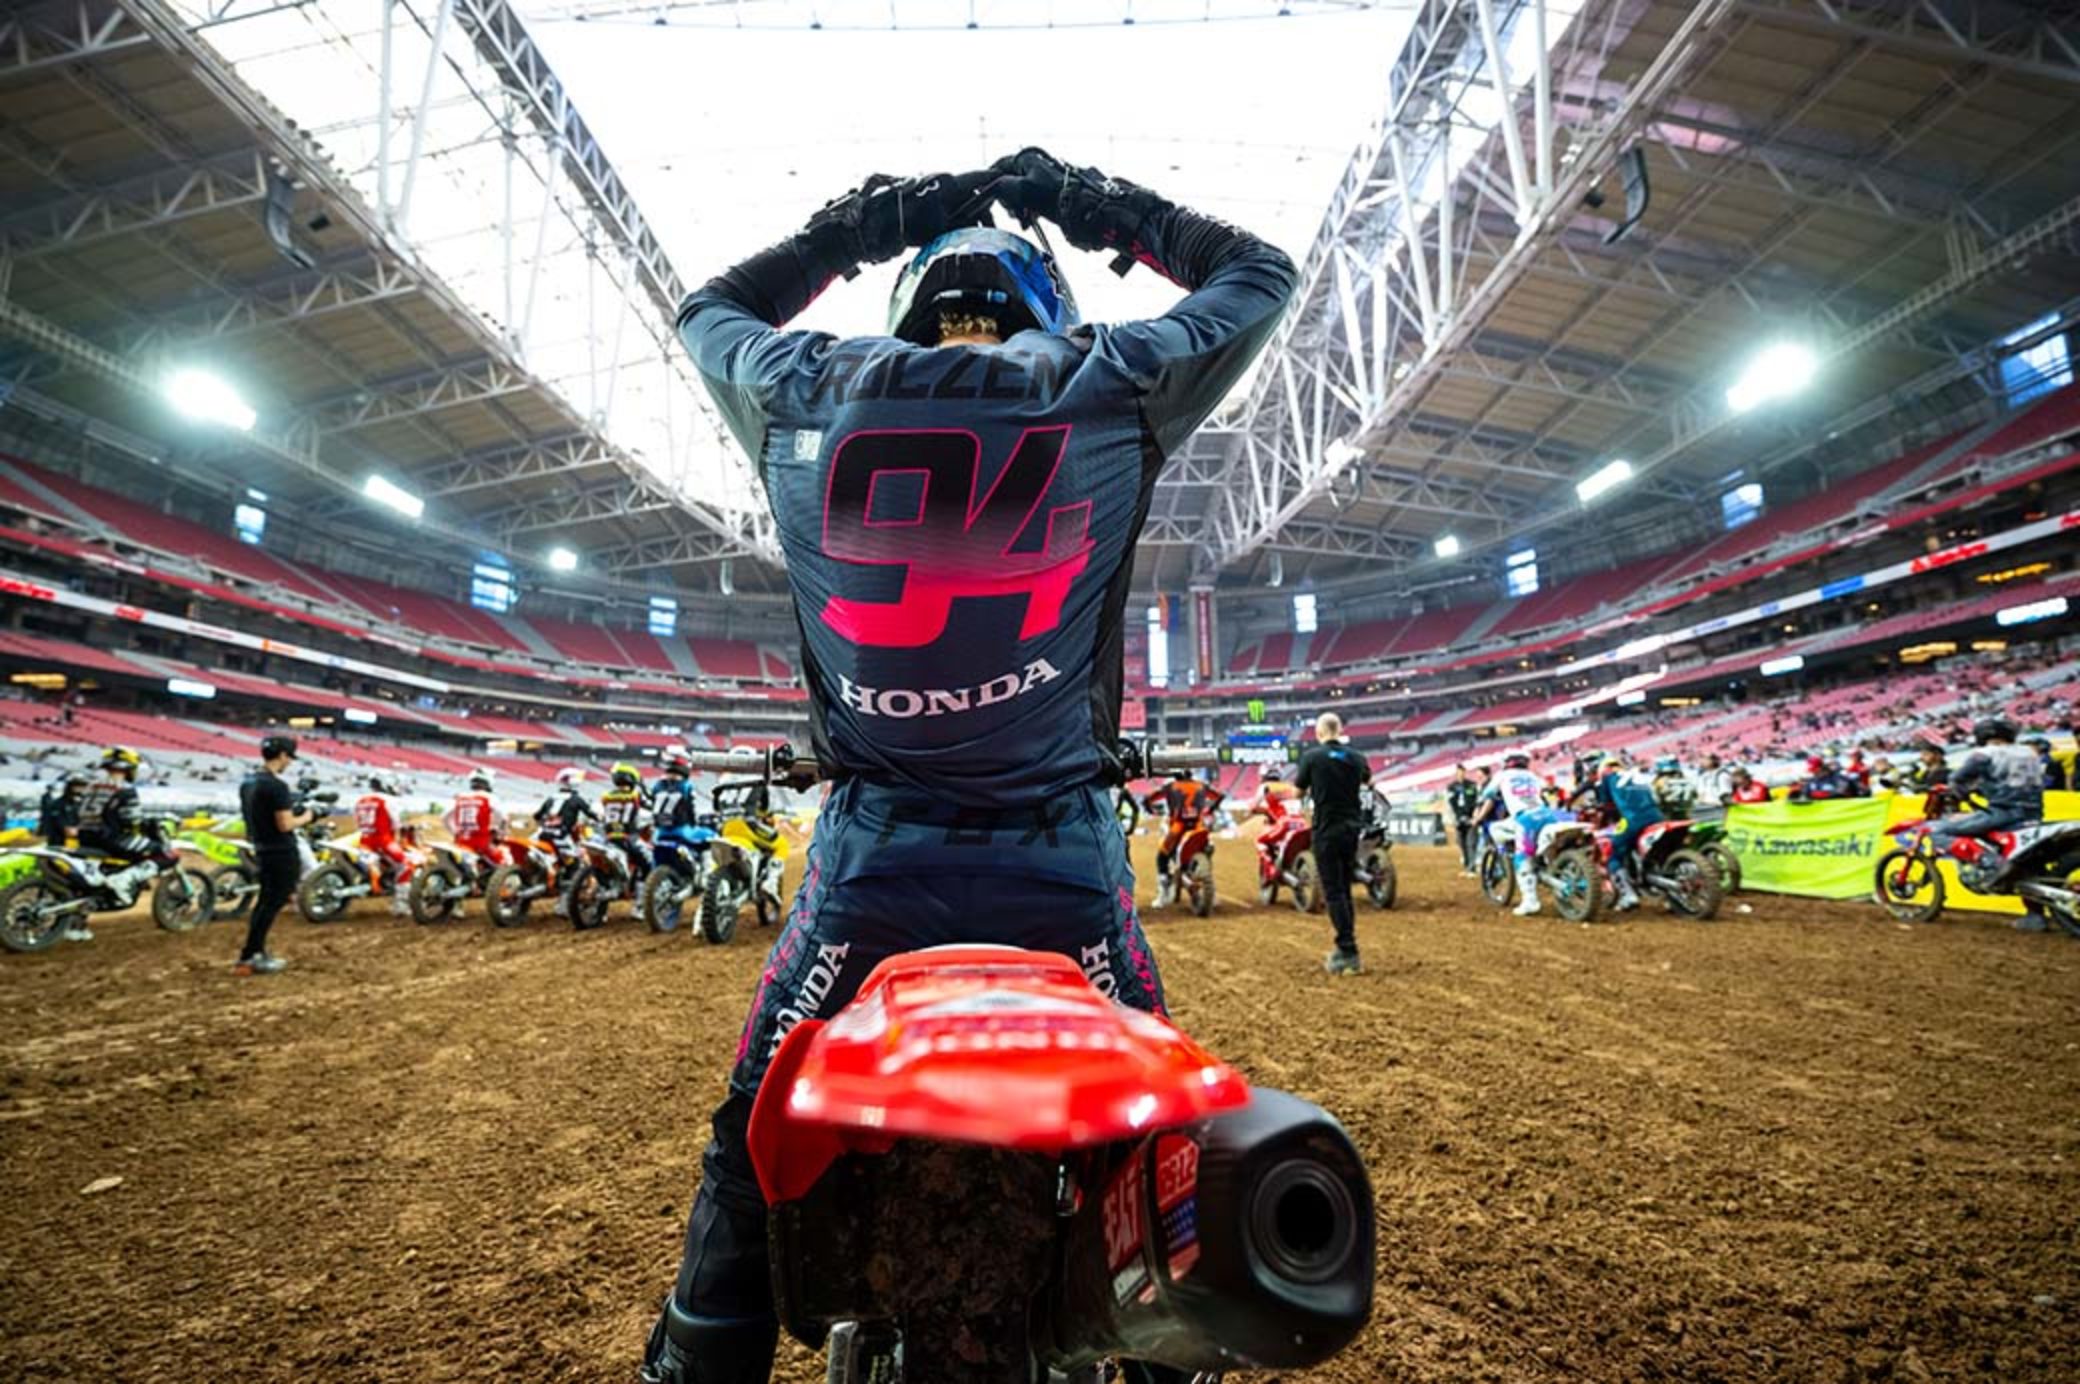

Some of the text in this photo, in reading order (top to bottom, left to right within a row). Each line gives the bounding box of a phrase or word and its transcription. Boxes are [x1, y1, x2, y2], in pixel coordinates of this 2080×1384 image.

[820, 424, 1097, 648] 94
[838, 657, 1063, 717] HONDA
[1386, 819, 1434, 835] KLEY
[1753, 832, 1873, 857] Kawasaki
[1081, 937, 1121, 1005] HO
